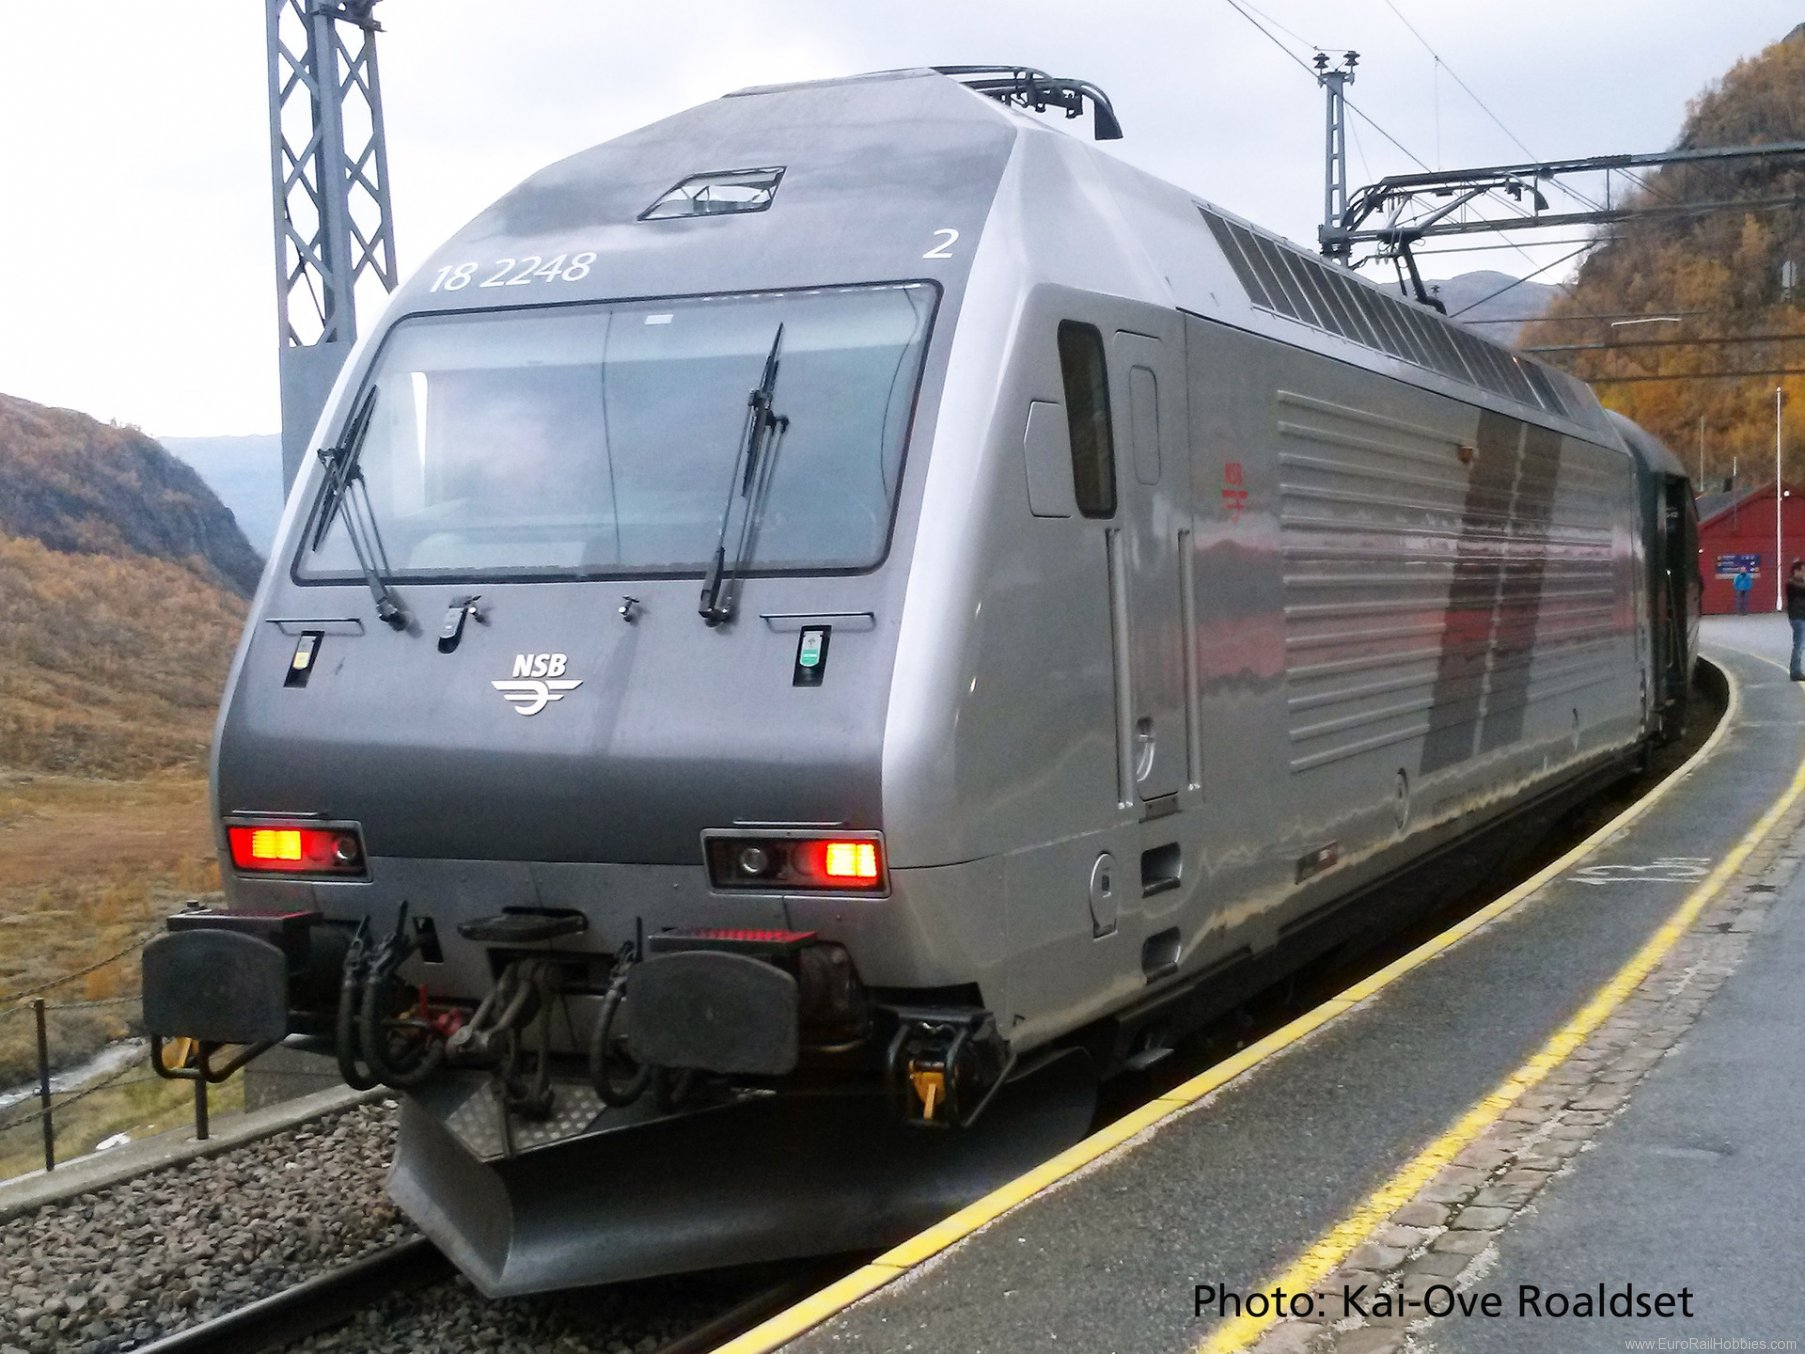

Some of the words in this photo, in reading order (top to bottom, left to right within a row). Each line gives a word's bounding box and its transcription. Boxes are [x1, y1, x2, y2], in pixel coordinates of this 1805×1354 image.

[922, 228, 959, 260] 2
[431, 263, 475, 292] 18
[481, 252, 597, 288] 2248
[512, 653, 568, 678] NSB
